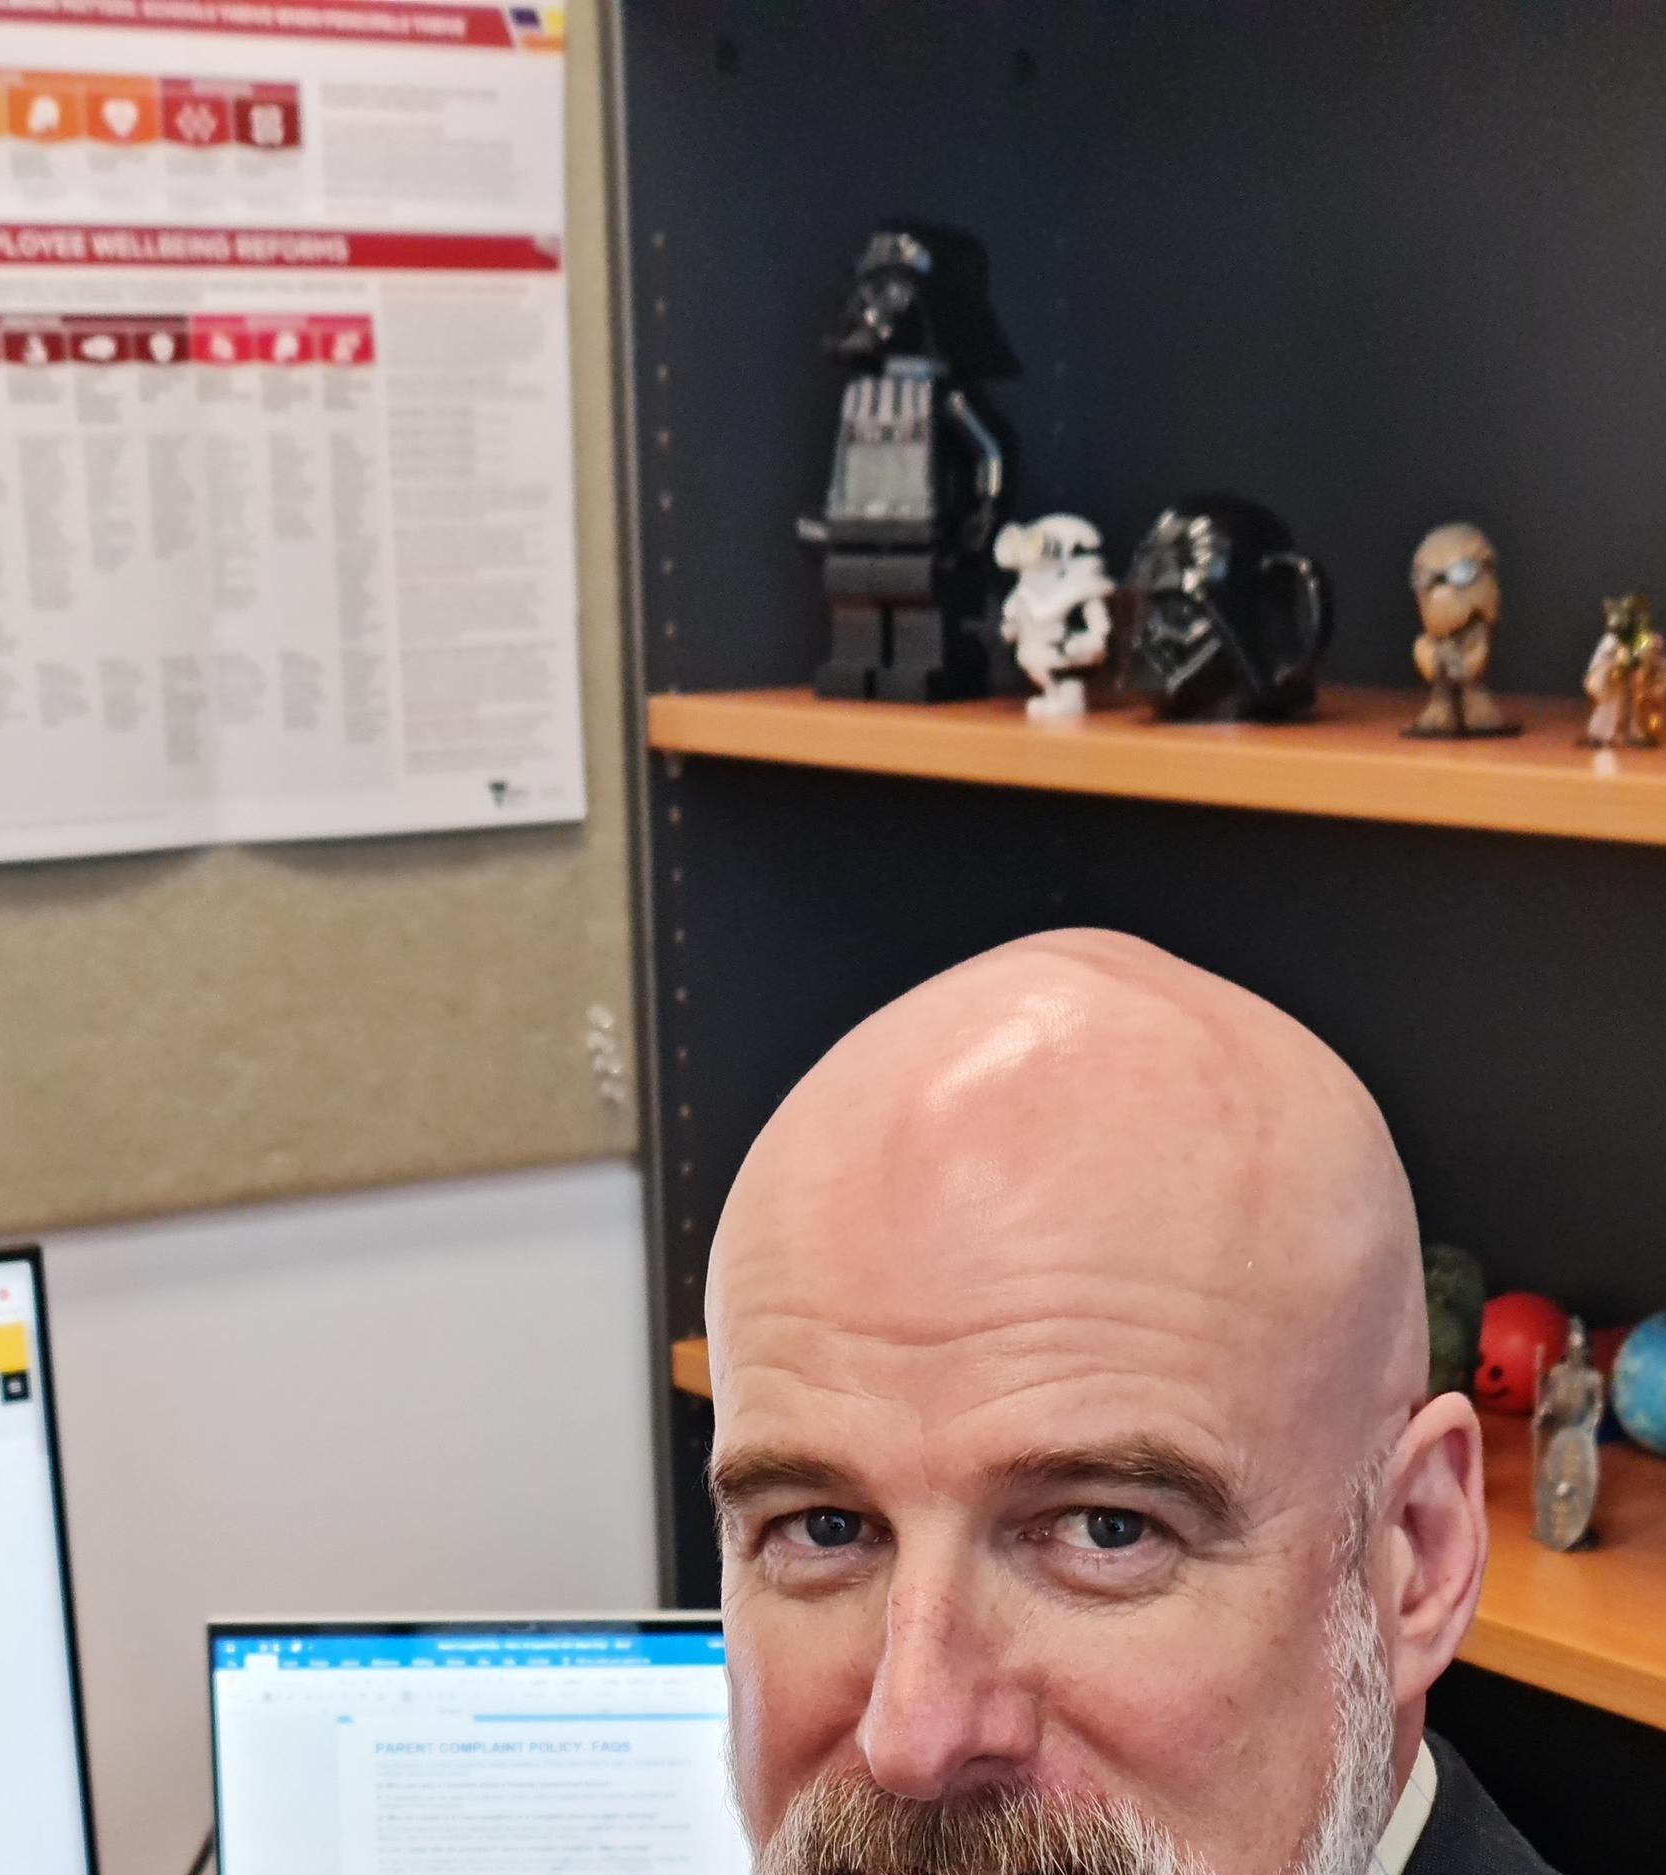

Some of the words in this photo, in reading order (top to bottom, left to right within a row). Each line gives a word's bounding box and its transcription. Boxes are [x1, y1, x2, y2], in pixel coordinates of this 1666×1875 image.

[91, 231, 230, 262] WELLBEING
[235, 234, 351, 265] REFORMS
[375, 1741, 434, 1755] PARENT
[438, 1740, 525, 1755] COMPLAINT
